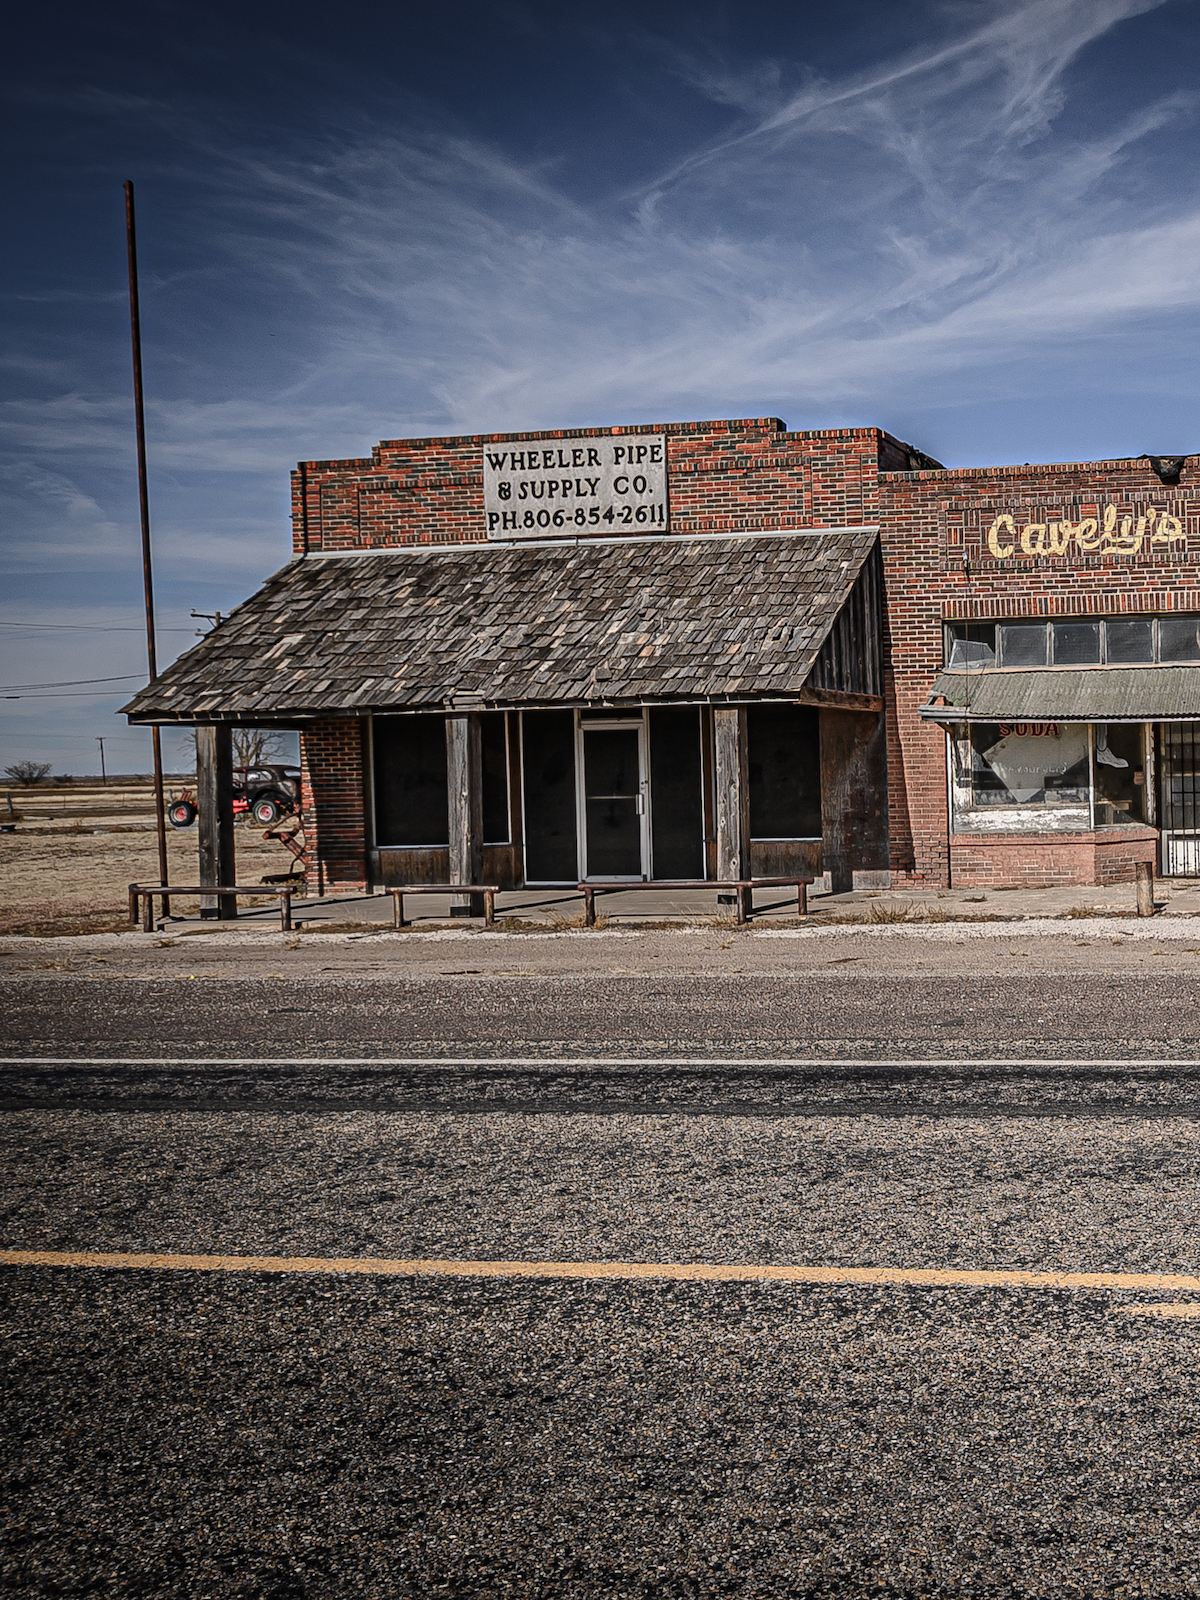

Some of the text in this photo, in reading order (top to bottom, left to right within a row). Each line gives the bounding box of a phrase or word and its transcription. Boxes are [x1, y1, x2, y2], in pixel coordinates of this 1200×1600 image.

[486, 444, 664, 471] WHEELER PIPE
[497, 475, 654, 500] & SUPPLY CO.
[999, 722, 1060, 737] SODA
